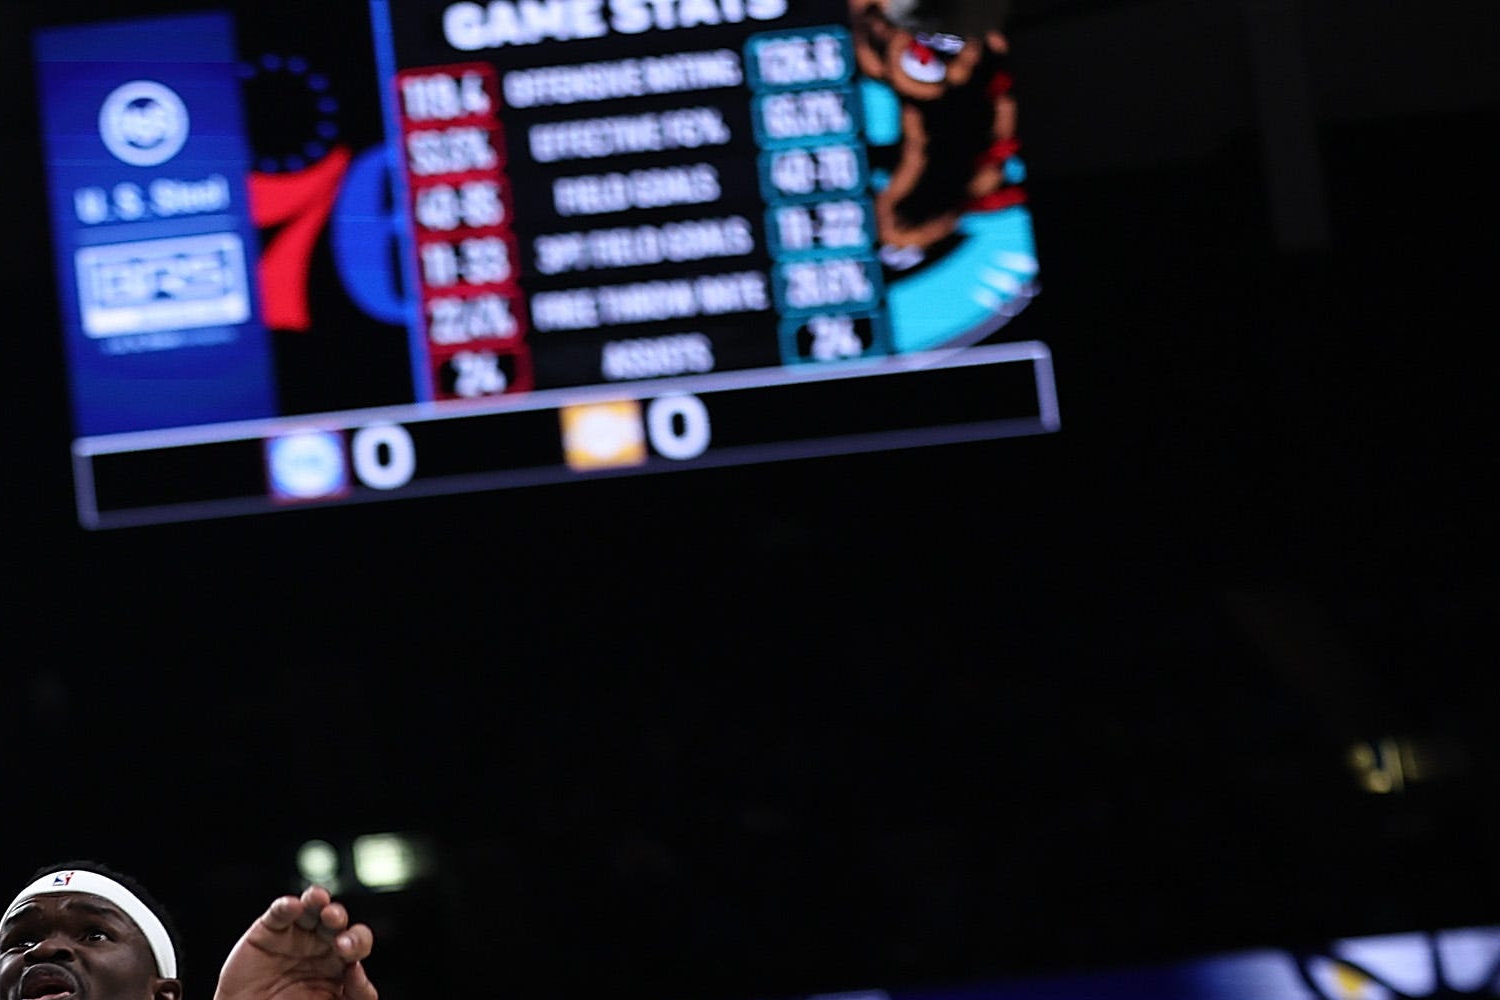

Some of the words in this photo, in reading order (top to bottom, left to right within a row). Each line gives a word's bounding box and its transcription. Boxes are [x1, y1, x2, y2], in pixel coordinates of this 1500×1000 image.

[442, 1, 608, 50] GAME
[609, 0, 788, 34] STATS
[149, 173, 231, 217] Steel
[647, 393, 711, 460] 0
[352, 423, 416, 490] 0
